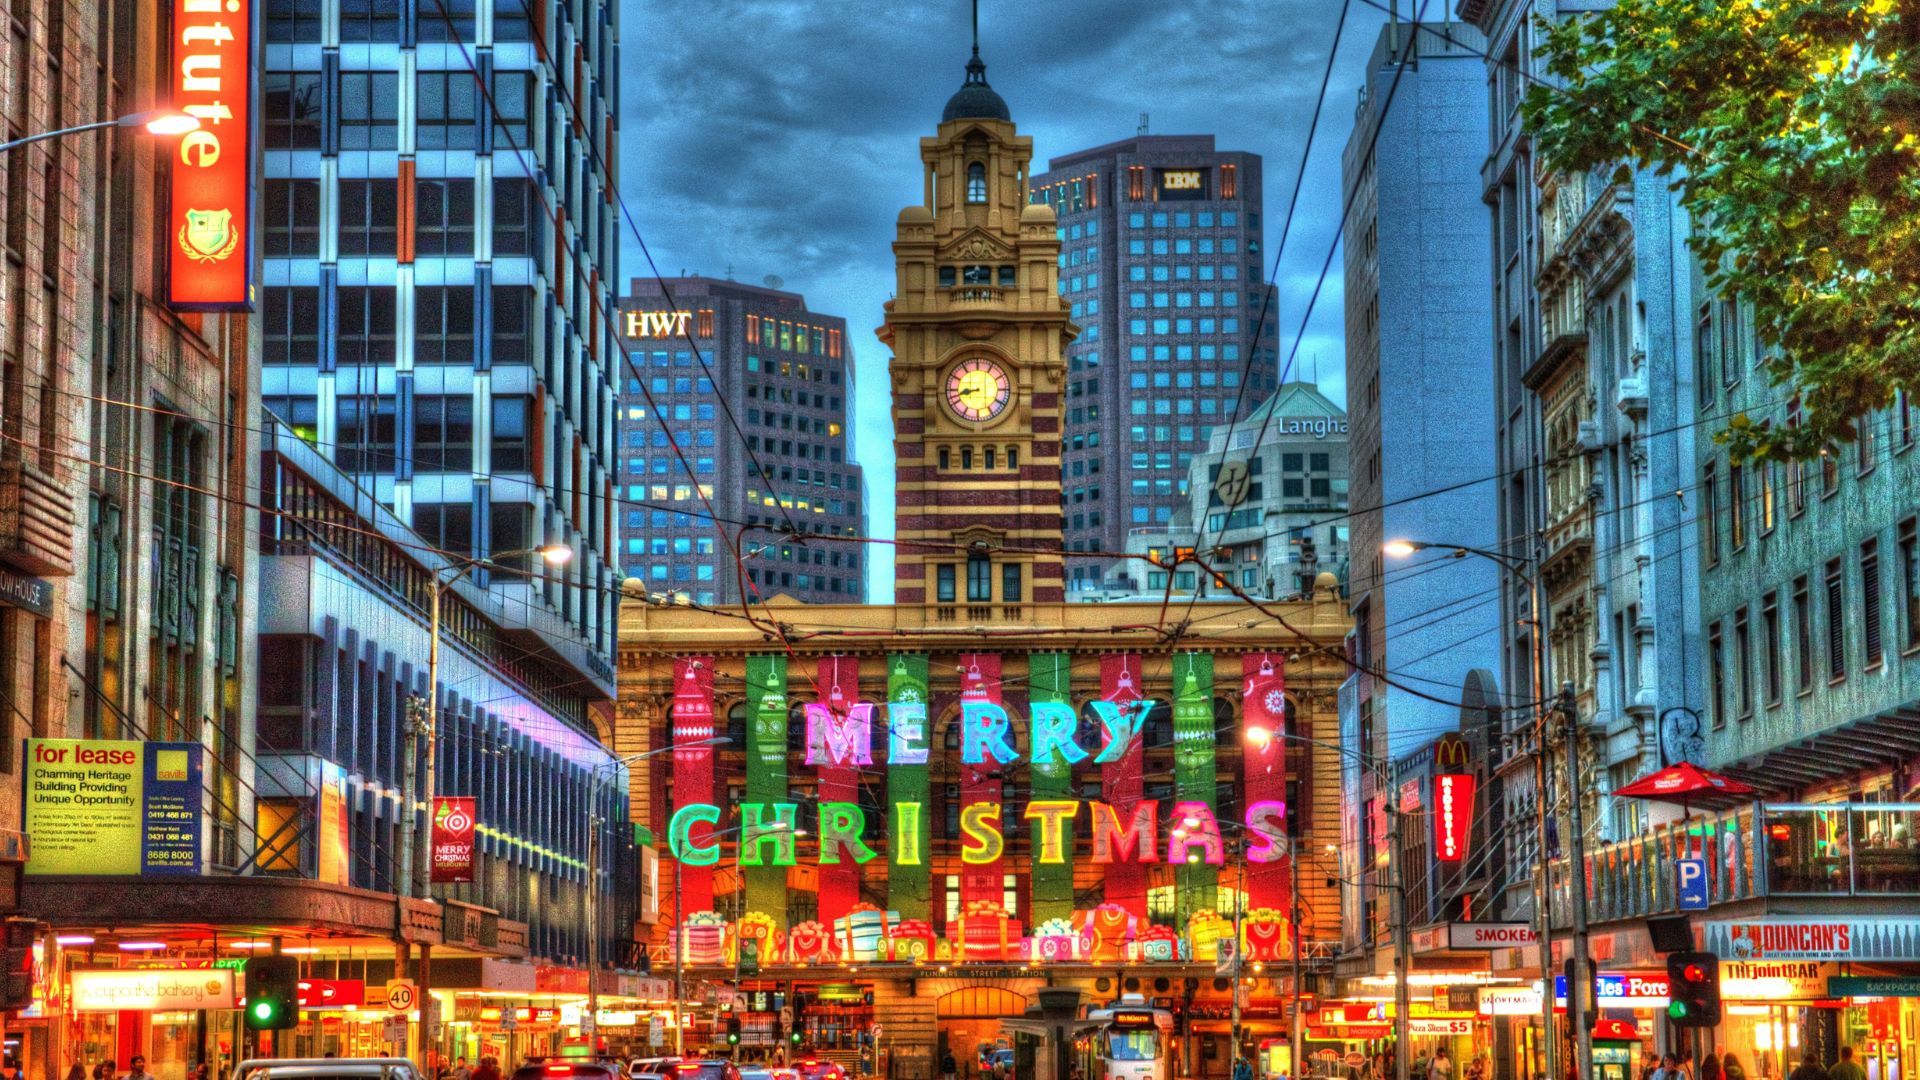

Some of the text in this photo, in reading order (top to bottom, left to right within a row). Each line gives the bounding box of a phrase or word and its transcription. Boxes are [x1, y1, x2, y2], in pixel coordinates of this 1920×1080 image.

[1164, 172, 1200, 189] IBM
[626, 312, 692, 337] HWT
[1280, 416, 1348, 438] Langha
[15, 577, 40, 606] HOUSE
[804, 700, 1155, 765] MERRY
[35, 744, 136, 764] for lease
[34, 768, 132, 782] Charming Heritage
[34, 782, 127, 794] Building Providing
[34, 794, 135, 806] Unique Opportunity
[668, 800, 1288, 866] CHRISTMAS
[147, 851, 194, 859] 8686 8000
[436, 845, 470, 854] MERRY
[1680, 862, 1700, 888] P
[1763, 924, 1850, 952] DUNCAN'S
[158, 981, 202, 1003] bakery
[391, 990, 410, 1003] 40
[1482, 996, 1538, 1004] SMOKEMAT
[608, 1027, 630, 1035] chips
[1409, 1022, 1467, 1033] Pizza Slices $5
